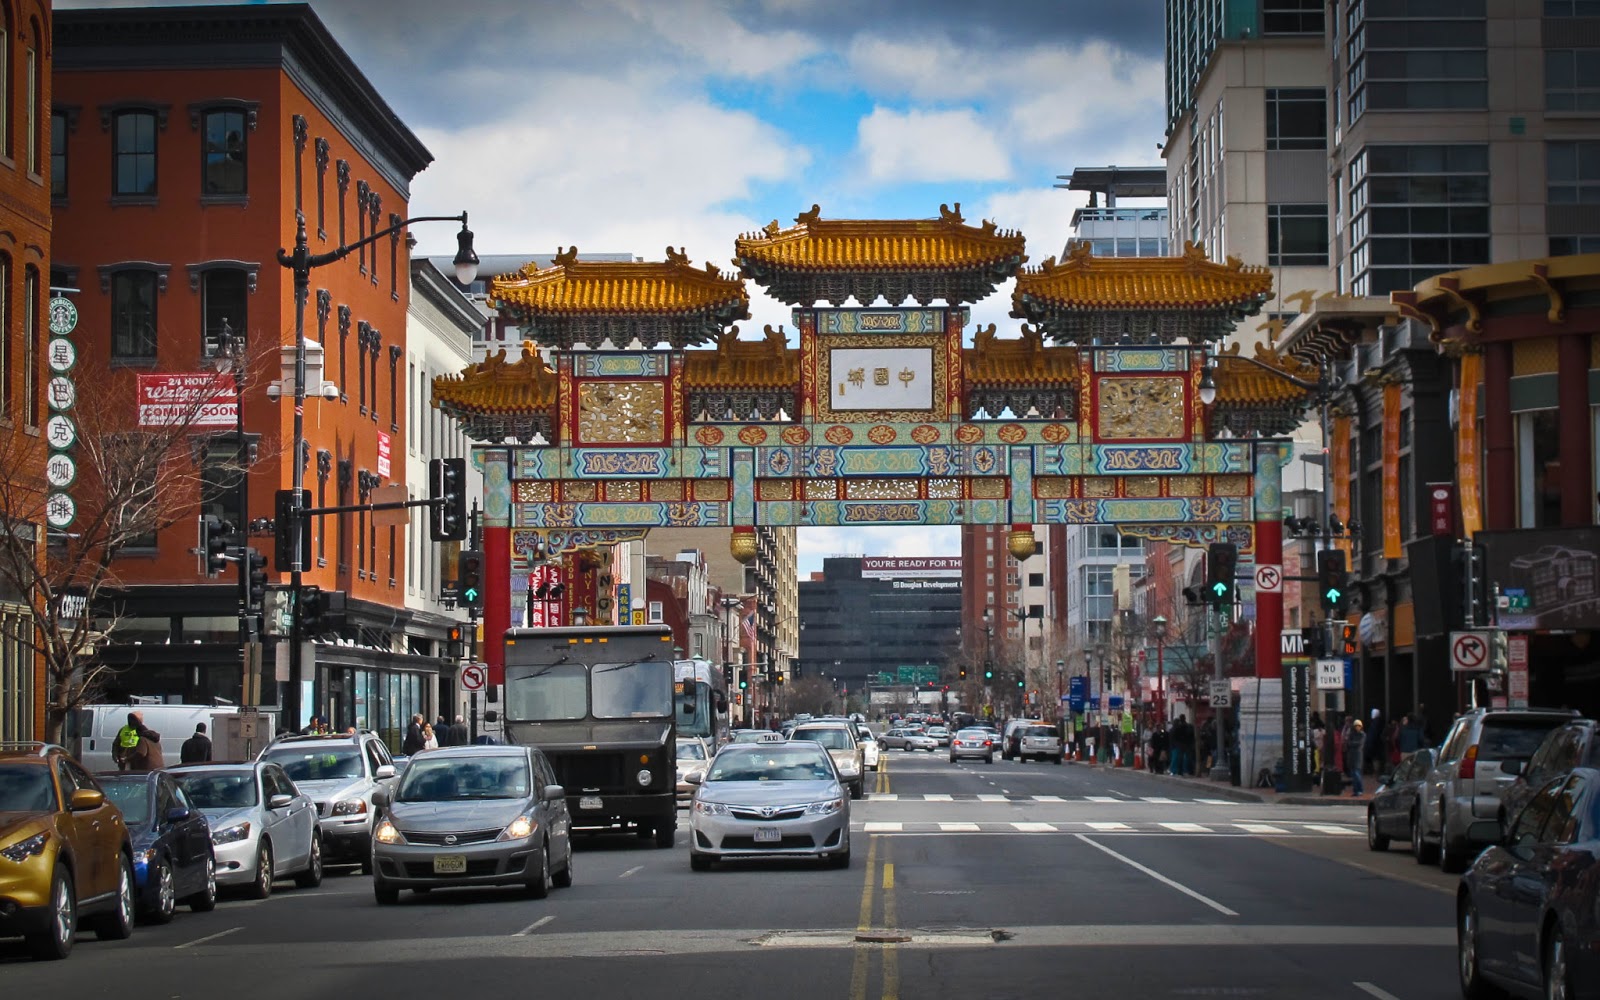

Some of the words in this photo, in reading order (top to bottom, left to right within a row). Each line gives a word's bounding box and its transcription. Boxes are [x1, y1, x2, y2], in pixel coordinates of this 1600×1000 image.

[168, 378, 181, 386] 24
[202, 406, 238, 416] SOON
[866, 560, 896, 568] YOU'RE
[929, 559, 947, 567] FOR
[949, 559, 962, 567] TH
[900, 581, 922, 589] Douglas
[923, 581, 958, 589] Development
[1281, 635, 1296, 653] M
[1323, 664, 1336, 673] NO
[1320, 676, 1341, 684] TURNS
[1213, 695, 1228, 705] 25
